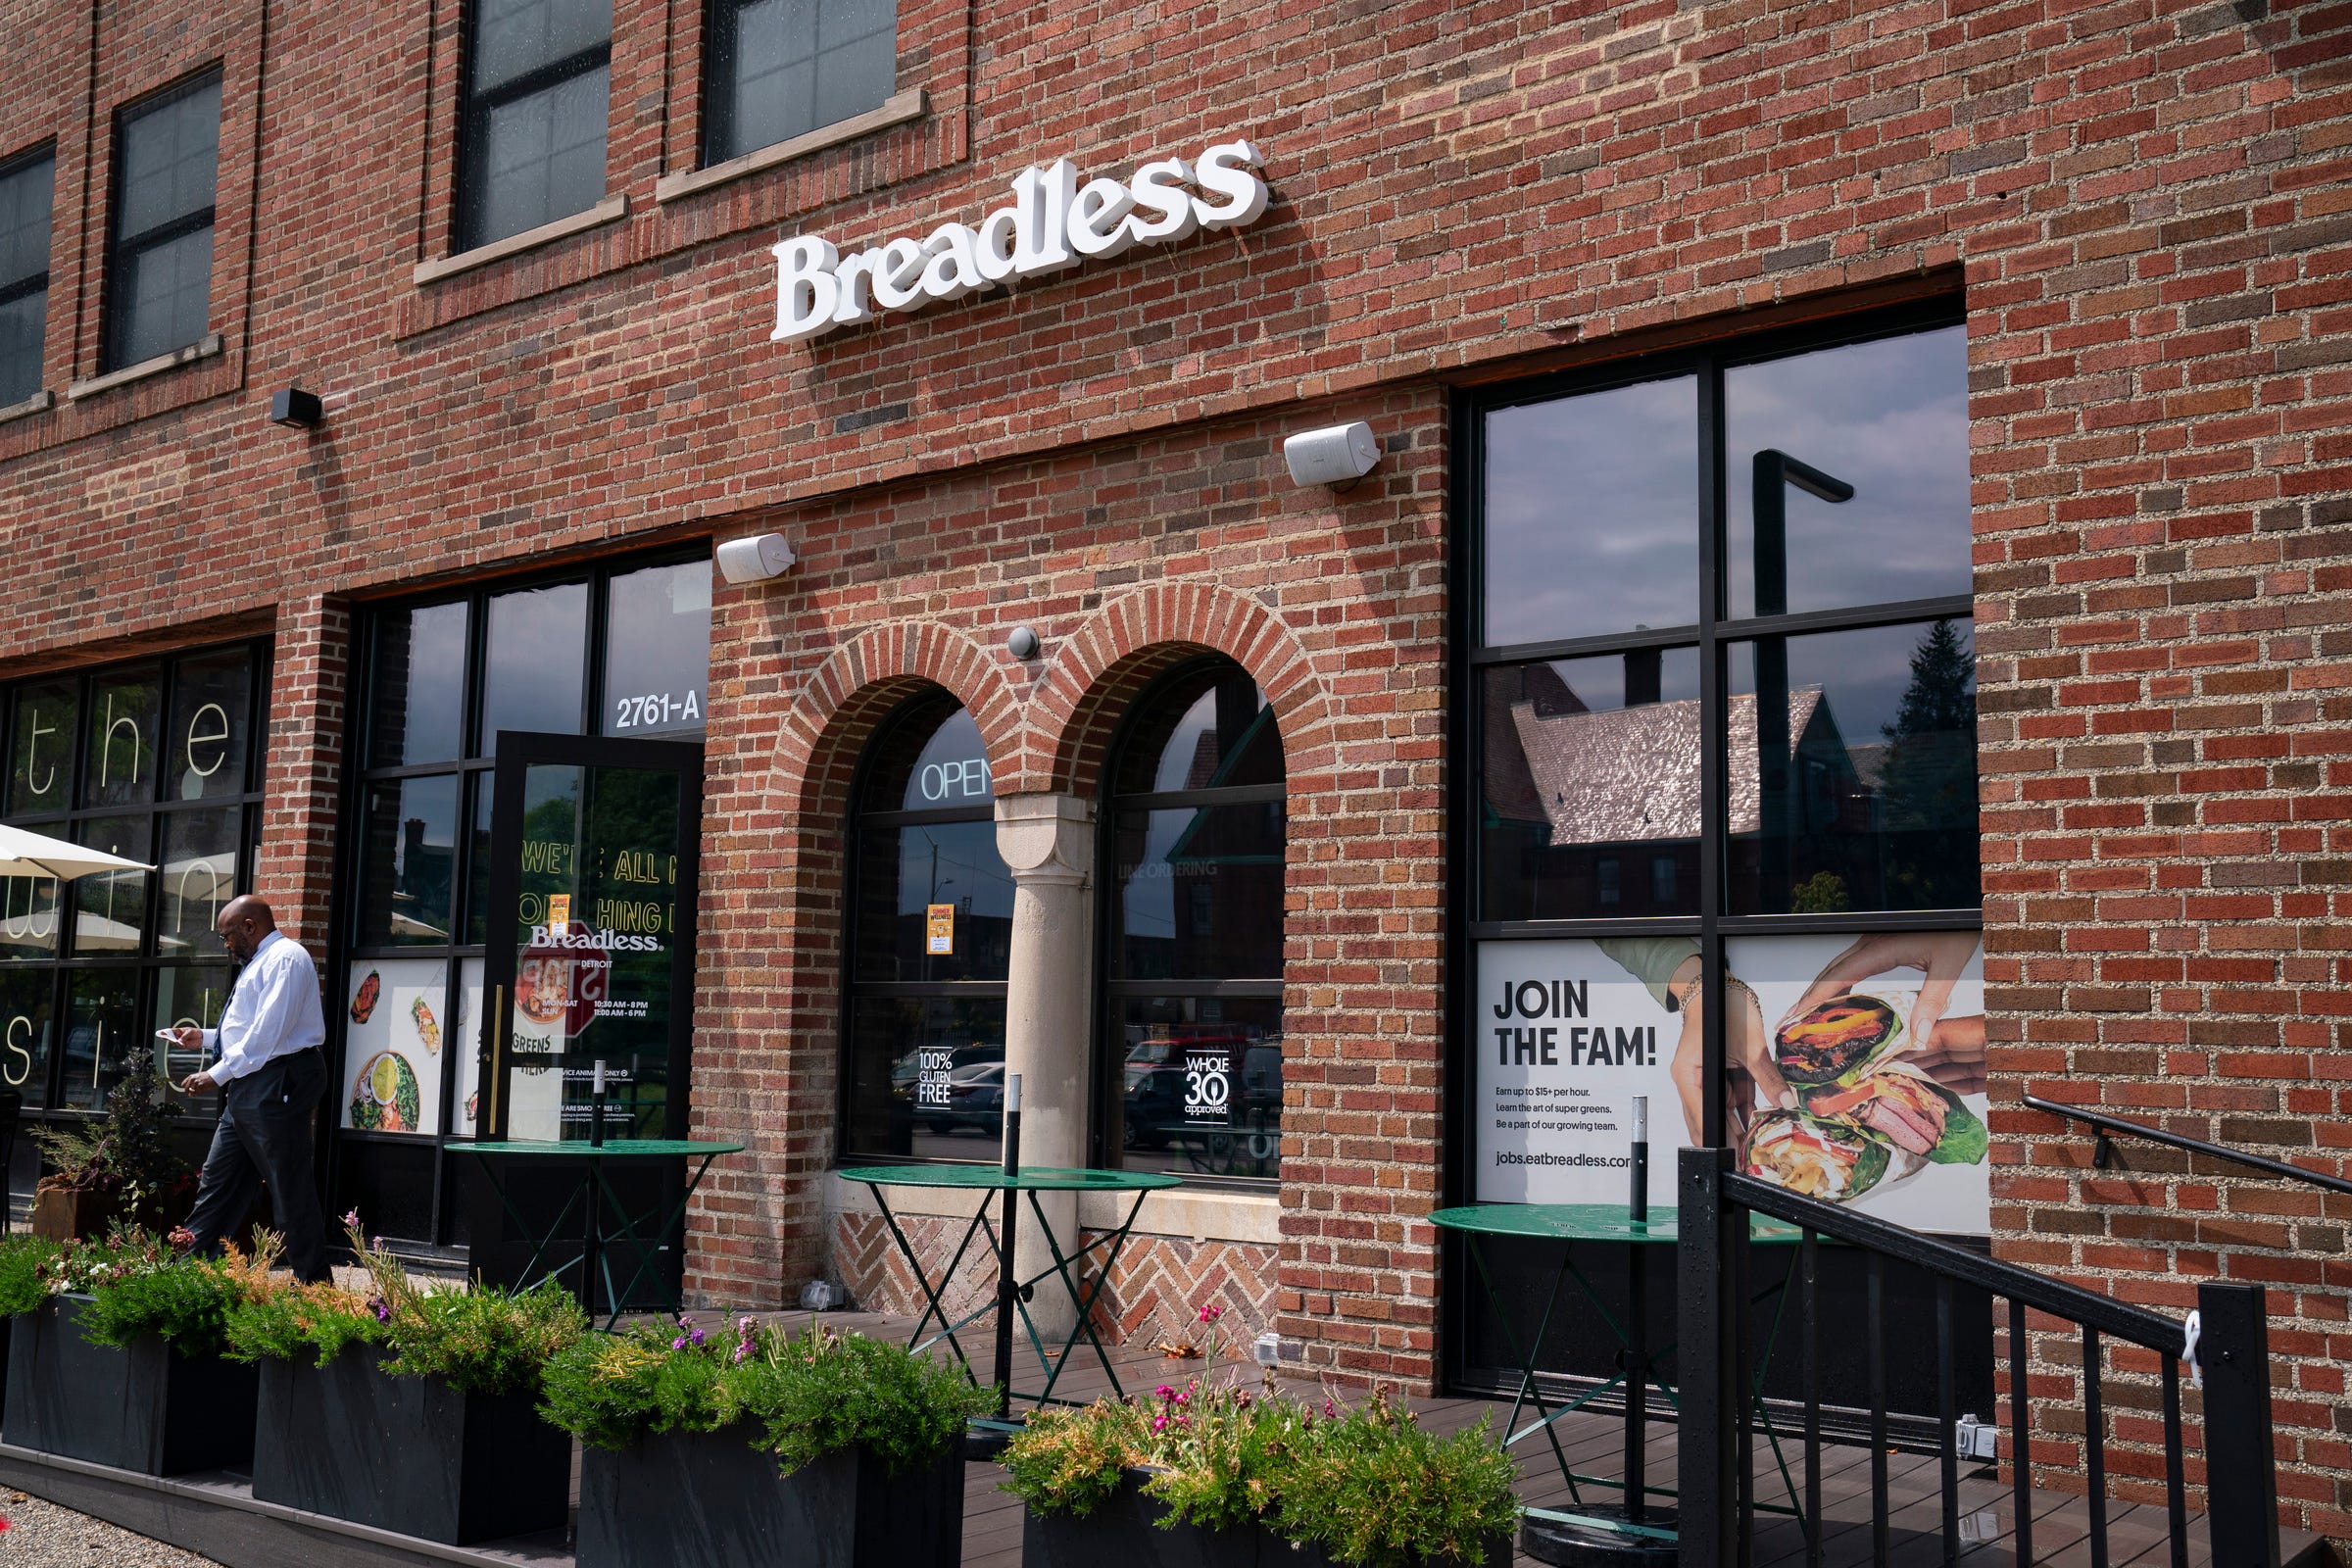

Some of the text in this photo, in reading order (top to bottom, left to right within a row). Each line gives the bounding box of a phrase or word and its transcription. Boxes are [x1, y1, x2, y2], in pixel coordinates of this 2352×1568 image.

[770, 138, 1268, 342] Breadless
[616, 690, 700, 728] 2761-A
[613, 850, 661, 884] ALL
[1146, 860, 1218, 878] ORDERING
[596, 898, 662, 933] HING
[1494, 979, 1589, 1020] JOIN
[513, 1032, 551, 1053] GREENS
[1494, 1026, 1656, 1066] THE FAM!
[919, 1053, 953, 1069] 100%
[1186, 1056, 1229, 1072] WHOLE
[919, 1070, 951, 1082] GLUTEN
[919, 1083, 951, 1103] FREE
[1185, 1071, 1229, 1105] 30
[1495, 1087, 1512, 1096] Earn
[1513, 1089, 1524, 1098] up
[1535, 1087, 1552, 1097] $15+
[1553, 1089, 1569, 1098] per
[1570, 1087, 1591, 1097] hour.
[1184, 1103, 1228, 1115] approved
[1495, 1103, 1517, 1112] Learn
[1518, 1103, 1532, 1112] the
[1544, 1103, 1554, 1112] of
[1554, 1105, 1579, 1114] super
[1580, 1105, 1612, 1115] greens.
[1513, 1120, 1530, 1130] part
[1531, 1120, 1541, 1129] of
[1556, 1121, 1592, 1132] growing
[1593, 1122, 1618, 1131] team.
